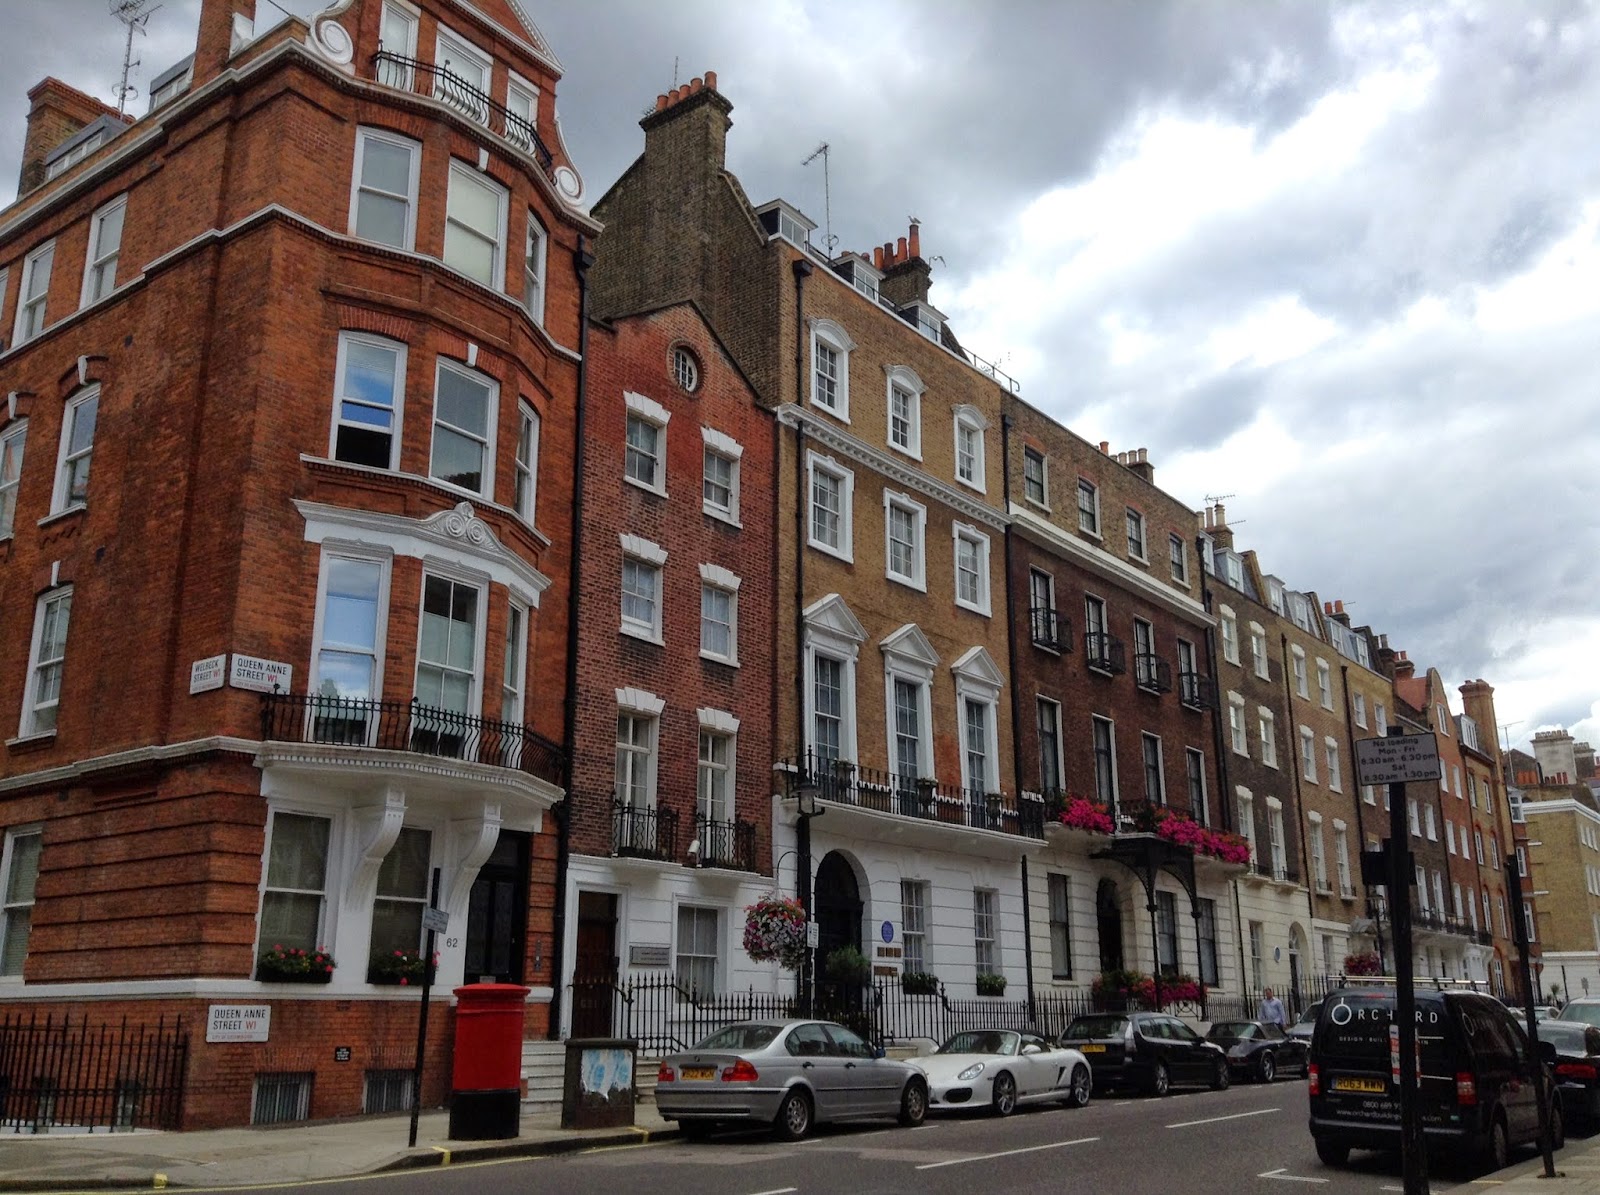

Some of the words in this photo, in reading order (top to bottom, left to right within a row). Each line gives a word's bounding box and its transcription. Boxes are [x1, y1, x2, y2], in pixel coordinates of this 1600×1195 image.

[195, 659, 219, 672] WELBECK
[237, 658, 263, 670] QUEEN
[266, 664, 287, 675] ANNE
[193, 671, 212, 683] STREET
[236, 668, 264, 680] STREET
[267, 674, 278, 682] W1
[1388, 738, 1419, 746] loading
[446, 938, 458, 948] 62
[214, 1009, 241, 1019] QUEEN
[244, 1009, 266, 1019] ANNE
[1331, 1002, 1438, 1025] ORCHRD
[213, 1020, 242, 1030] STREET
